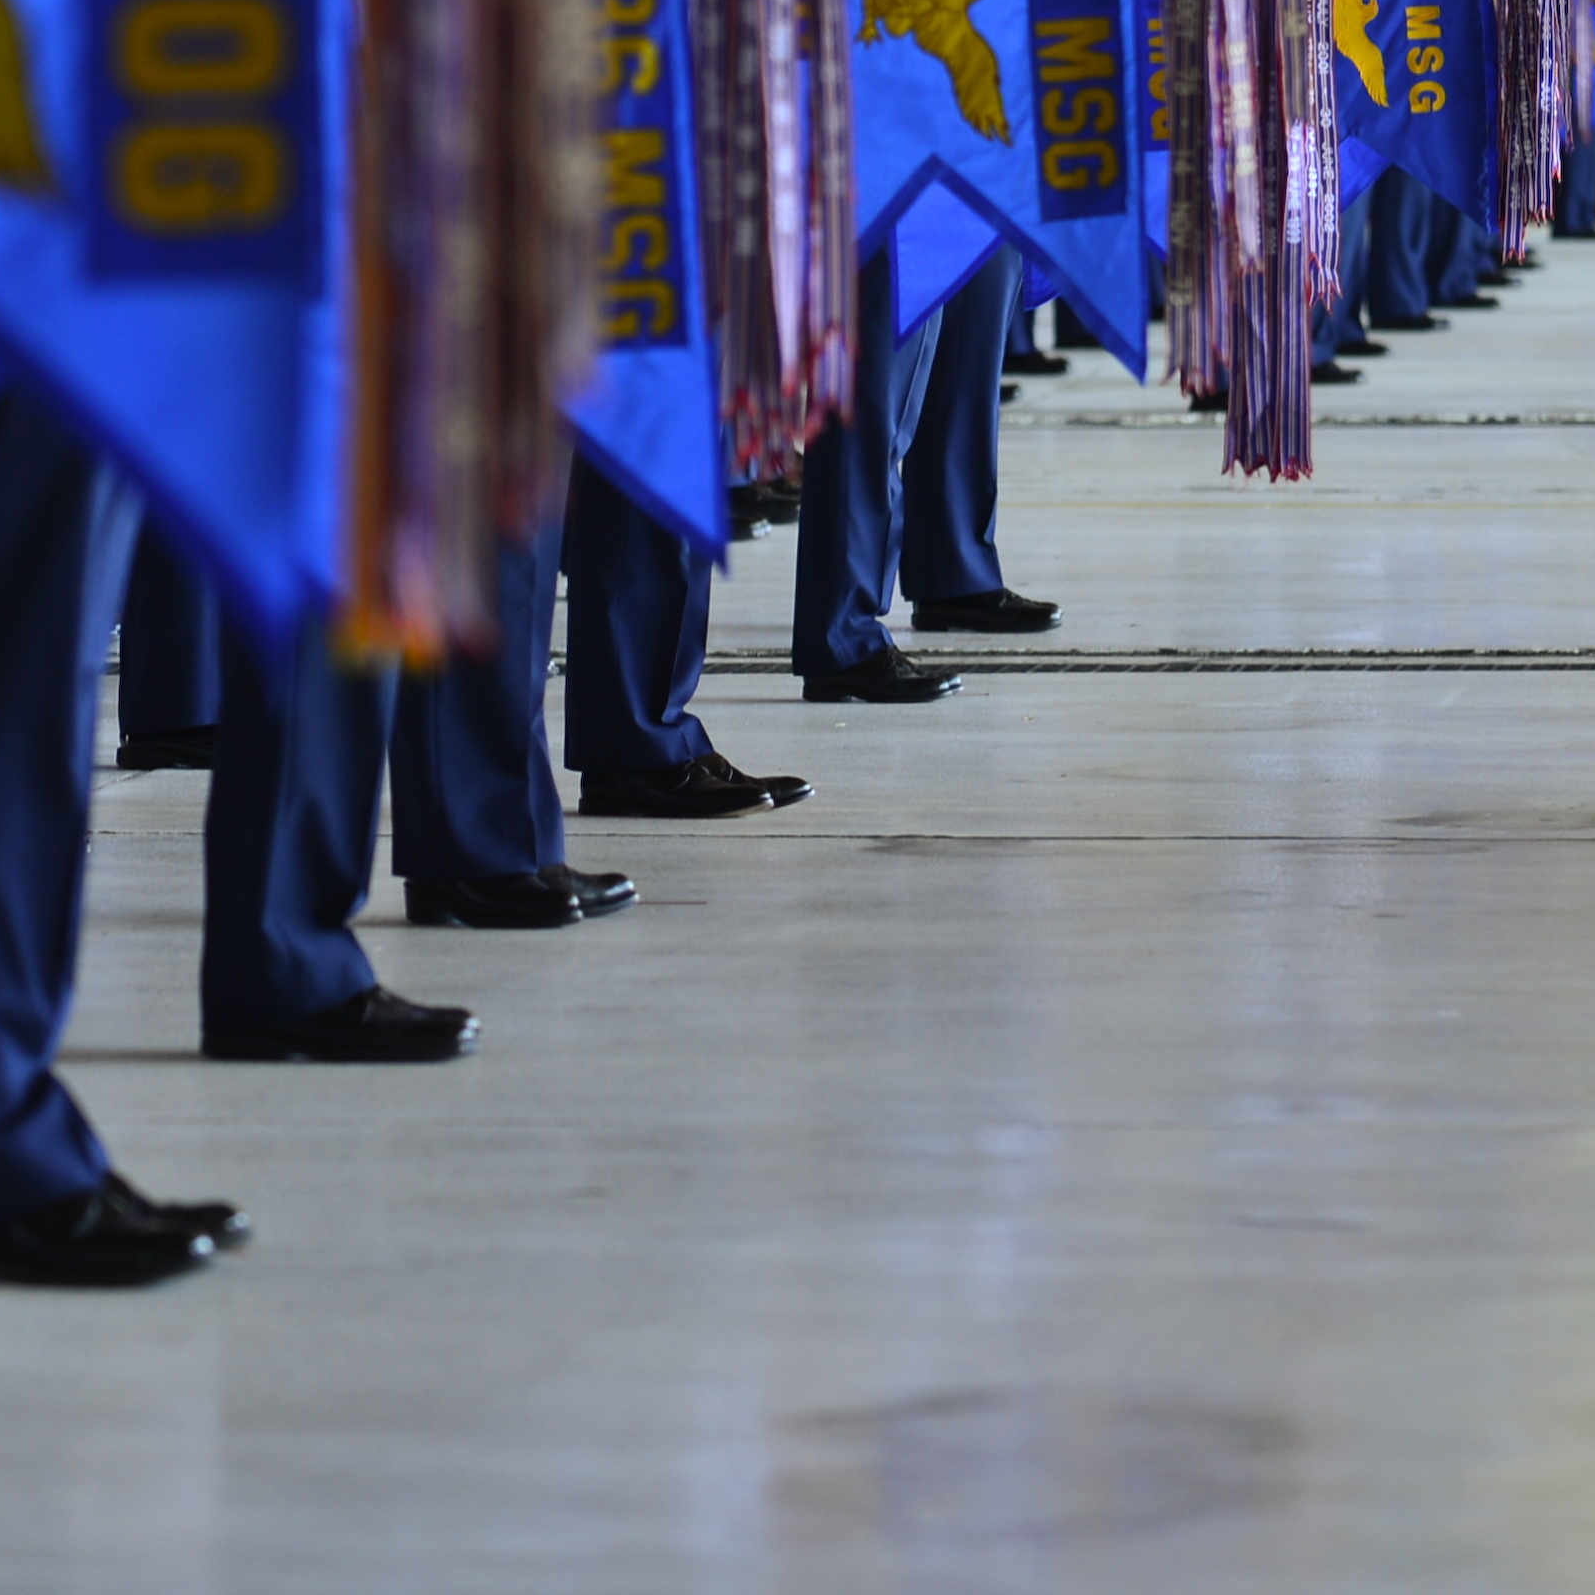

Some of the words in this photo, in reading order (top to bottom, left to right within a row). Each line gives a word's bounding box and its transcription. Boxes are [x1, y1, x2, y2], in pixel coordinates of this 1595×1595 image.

[1317, 41, 1329, 74] 2001
[1406, 5, 1446, 113] MSG
[1034, 17, 1118, 191] MSG
[1320, 108, 1332, 127] 30
[1322, 142, 1335, 180] JUNE
[598, 129, 674, 339] MSG
[1172, 202, 1193, 248] NOV
[1324, 193, 1336, 233] 2002
